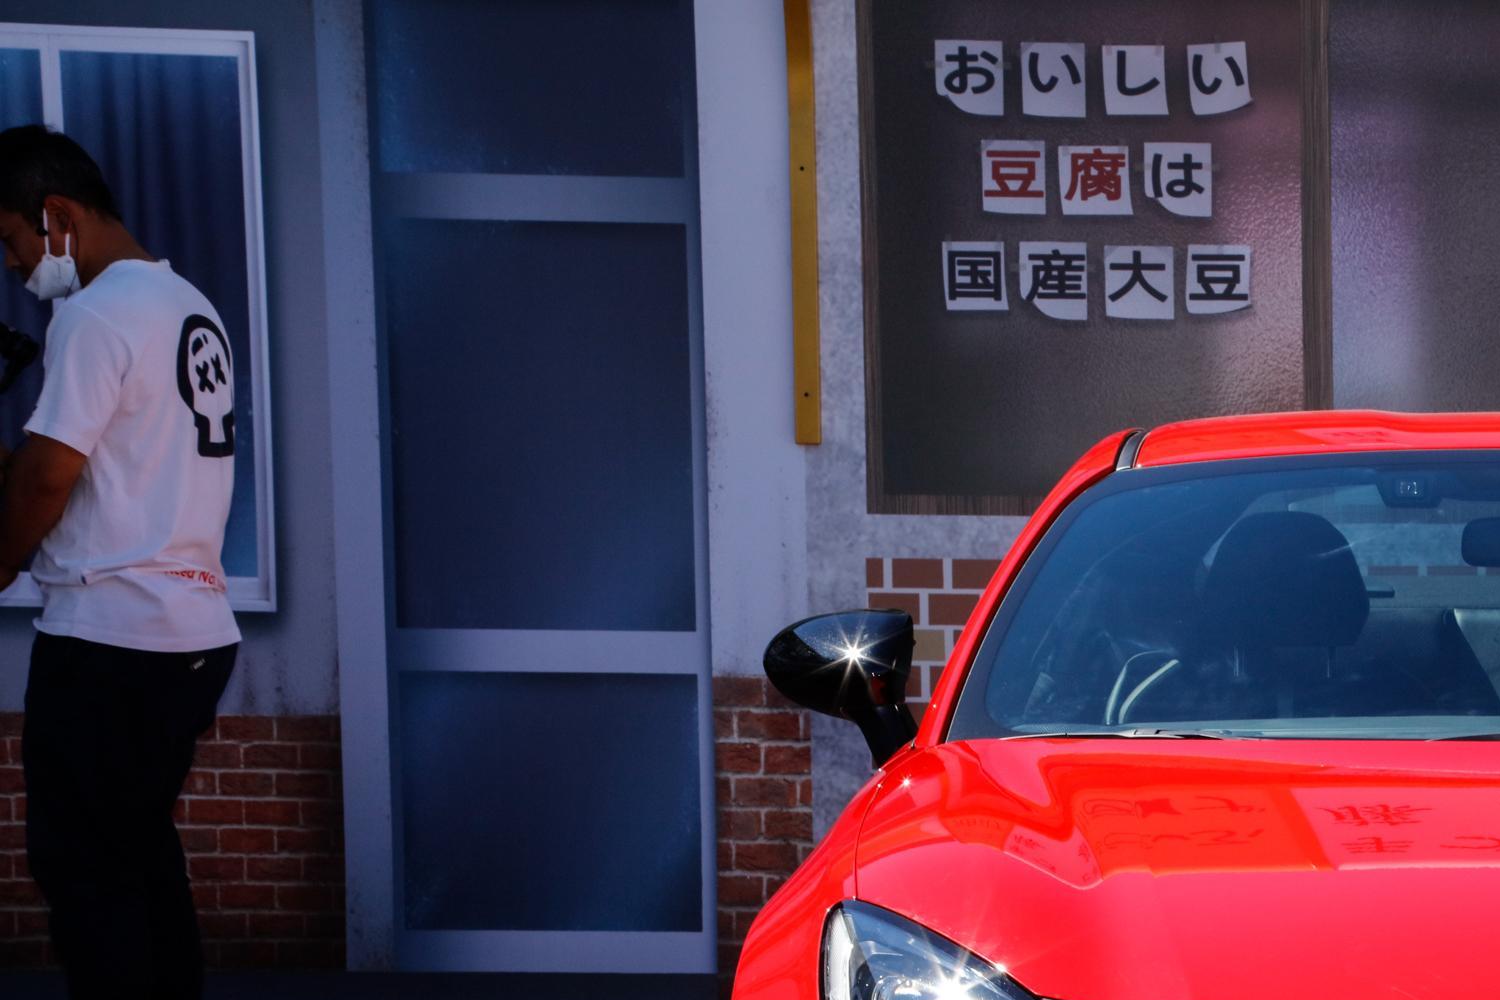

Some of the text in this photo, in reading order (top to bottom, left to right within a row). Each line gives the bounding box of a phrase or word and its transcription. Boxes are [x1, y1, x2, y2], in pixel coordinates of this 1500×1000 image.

[944, 46, 1245, 96] おいしい
[984, 148, 1205, 201] 豆腐は
[947, 249, 1249, 303] 国産大豆
